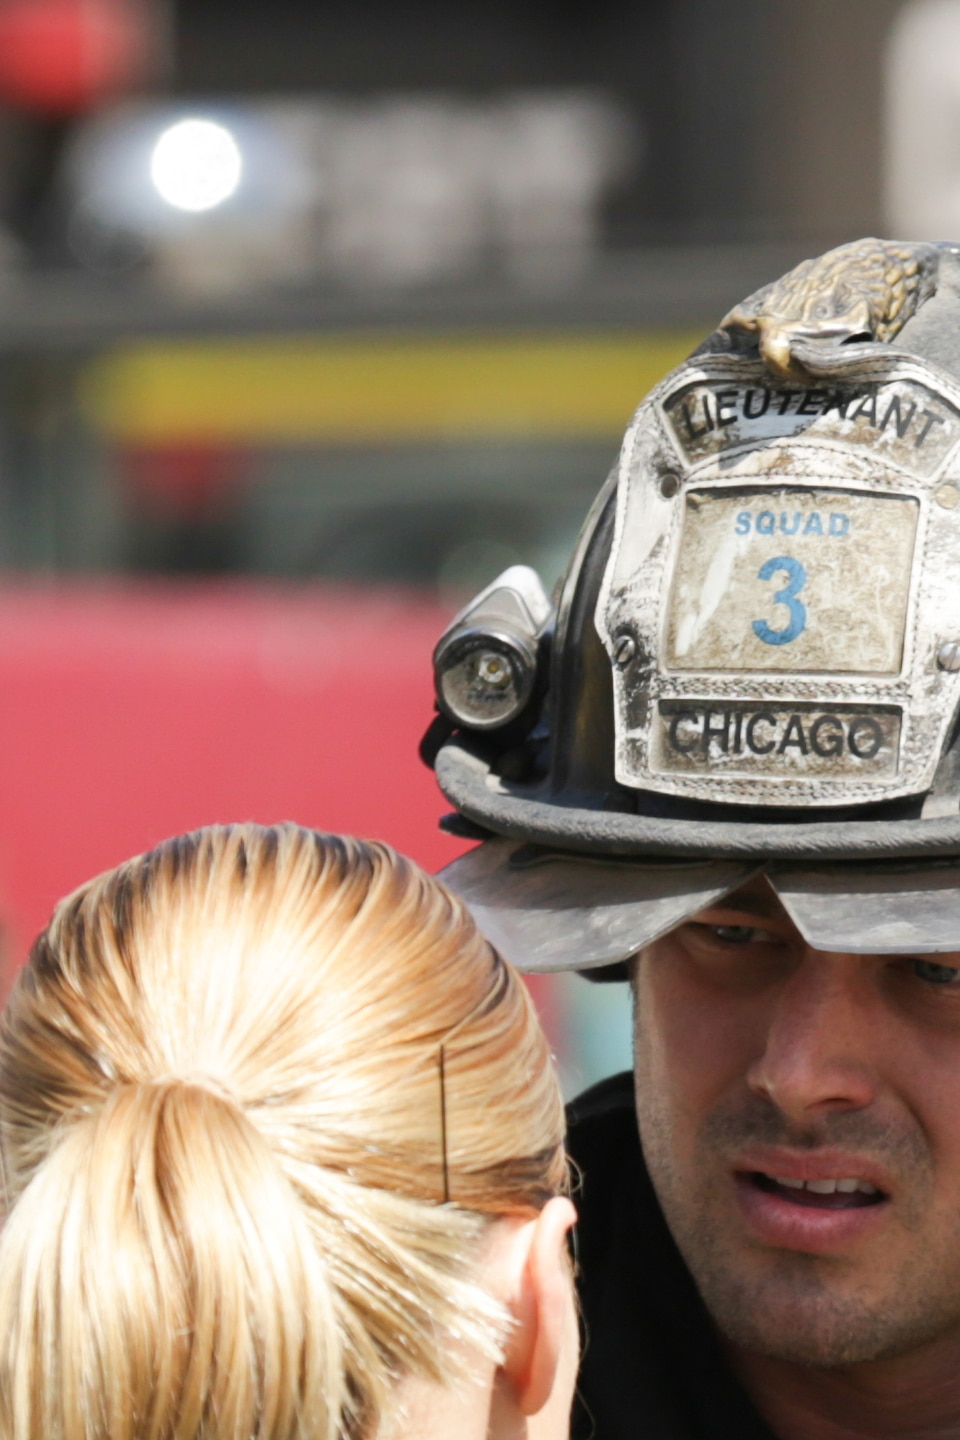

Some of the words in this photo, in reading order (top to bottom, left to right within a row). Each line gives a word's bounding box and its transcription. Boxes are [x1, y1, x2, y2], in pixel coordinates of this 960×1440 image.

[681, 387, 944, 448] LIEUTENANT
[734, 511, 851, 537] SQUAD
[752, 556, 808, 646] 3
[668, 711, 885, 760] CHICAGO
